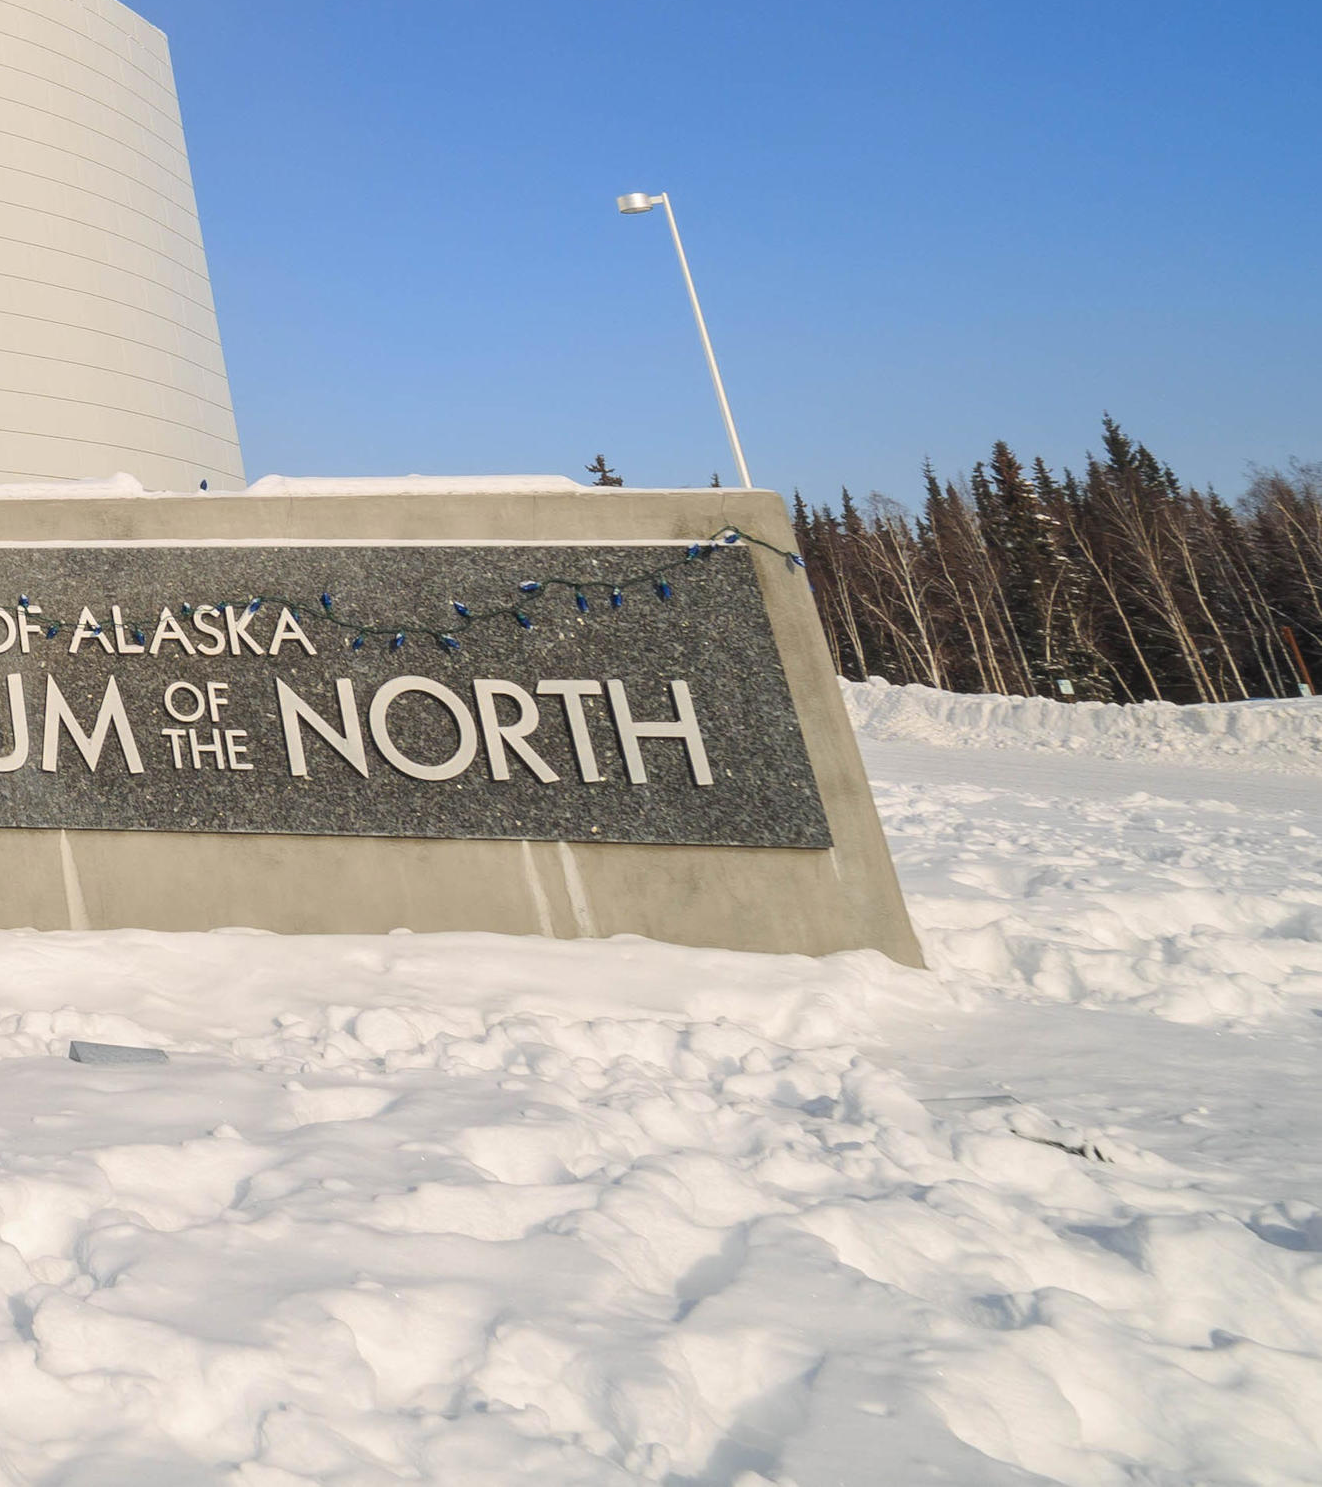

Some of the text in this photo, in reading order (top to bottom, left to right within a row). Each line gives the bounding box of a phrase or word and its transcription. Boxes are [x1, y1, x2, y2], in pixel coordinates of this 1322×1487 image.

[68, 605, 318, 656] ALASKA
[164, 681, 229, 723] OF
[161, 727, 255, 770] THE
[276, 675, 714, 786] NORTH
